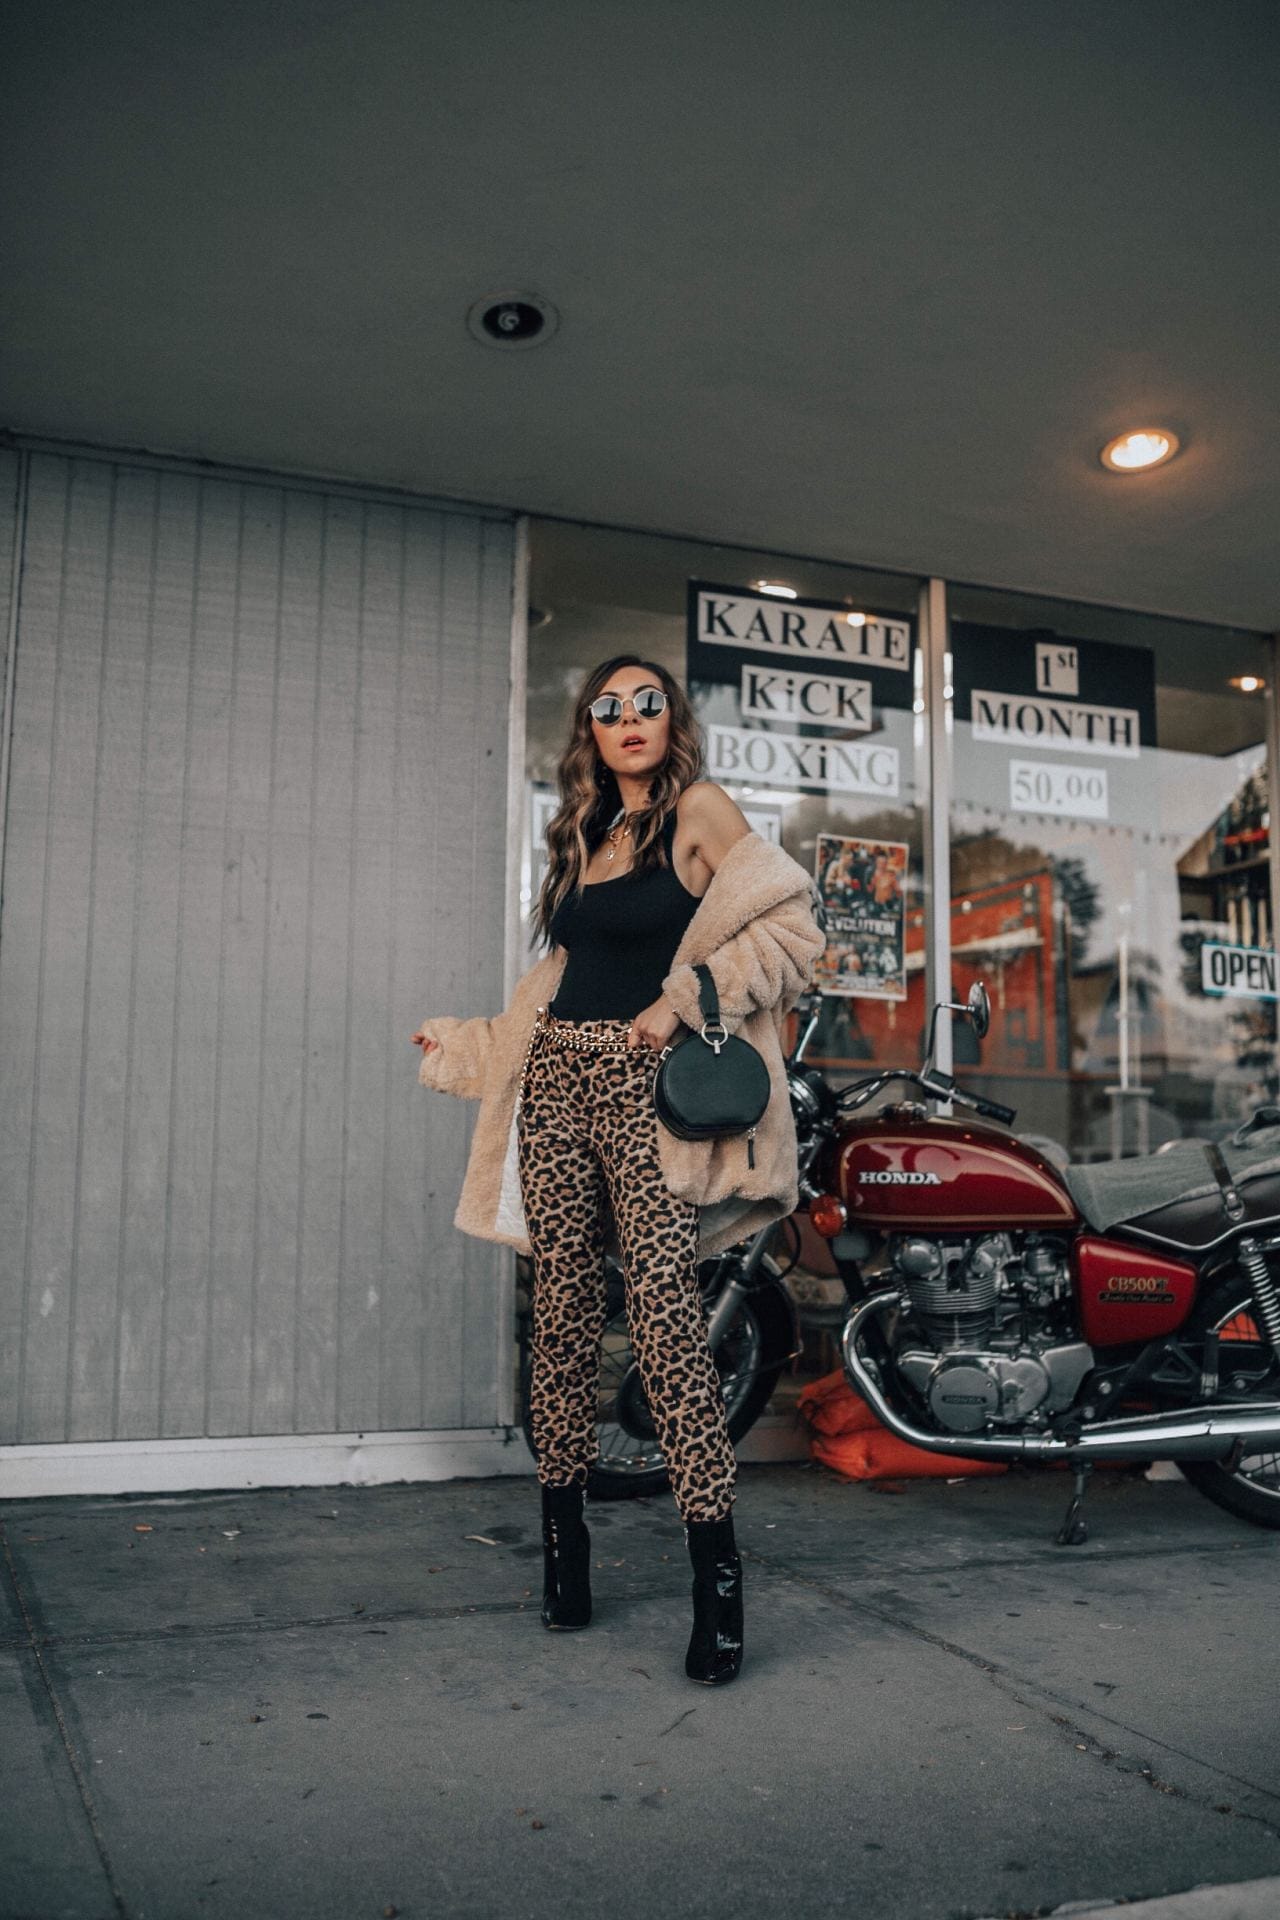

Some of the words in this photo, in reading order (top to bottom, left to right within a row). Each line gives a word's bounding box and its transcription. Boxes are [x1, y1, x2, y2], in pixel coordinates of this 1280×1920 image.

[704, 599, 906, 662] KARATE
[1040, 647, 1077, 688] 1st
[976, 698, 1133, 747] MONTH
[1014, 769, 1104, 805] 50.00
[1211, 950, 1276, 991] OPEN
[858, 1171, 942, 1185] HONDA
